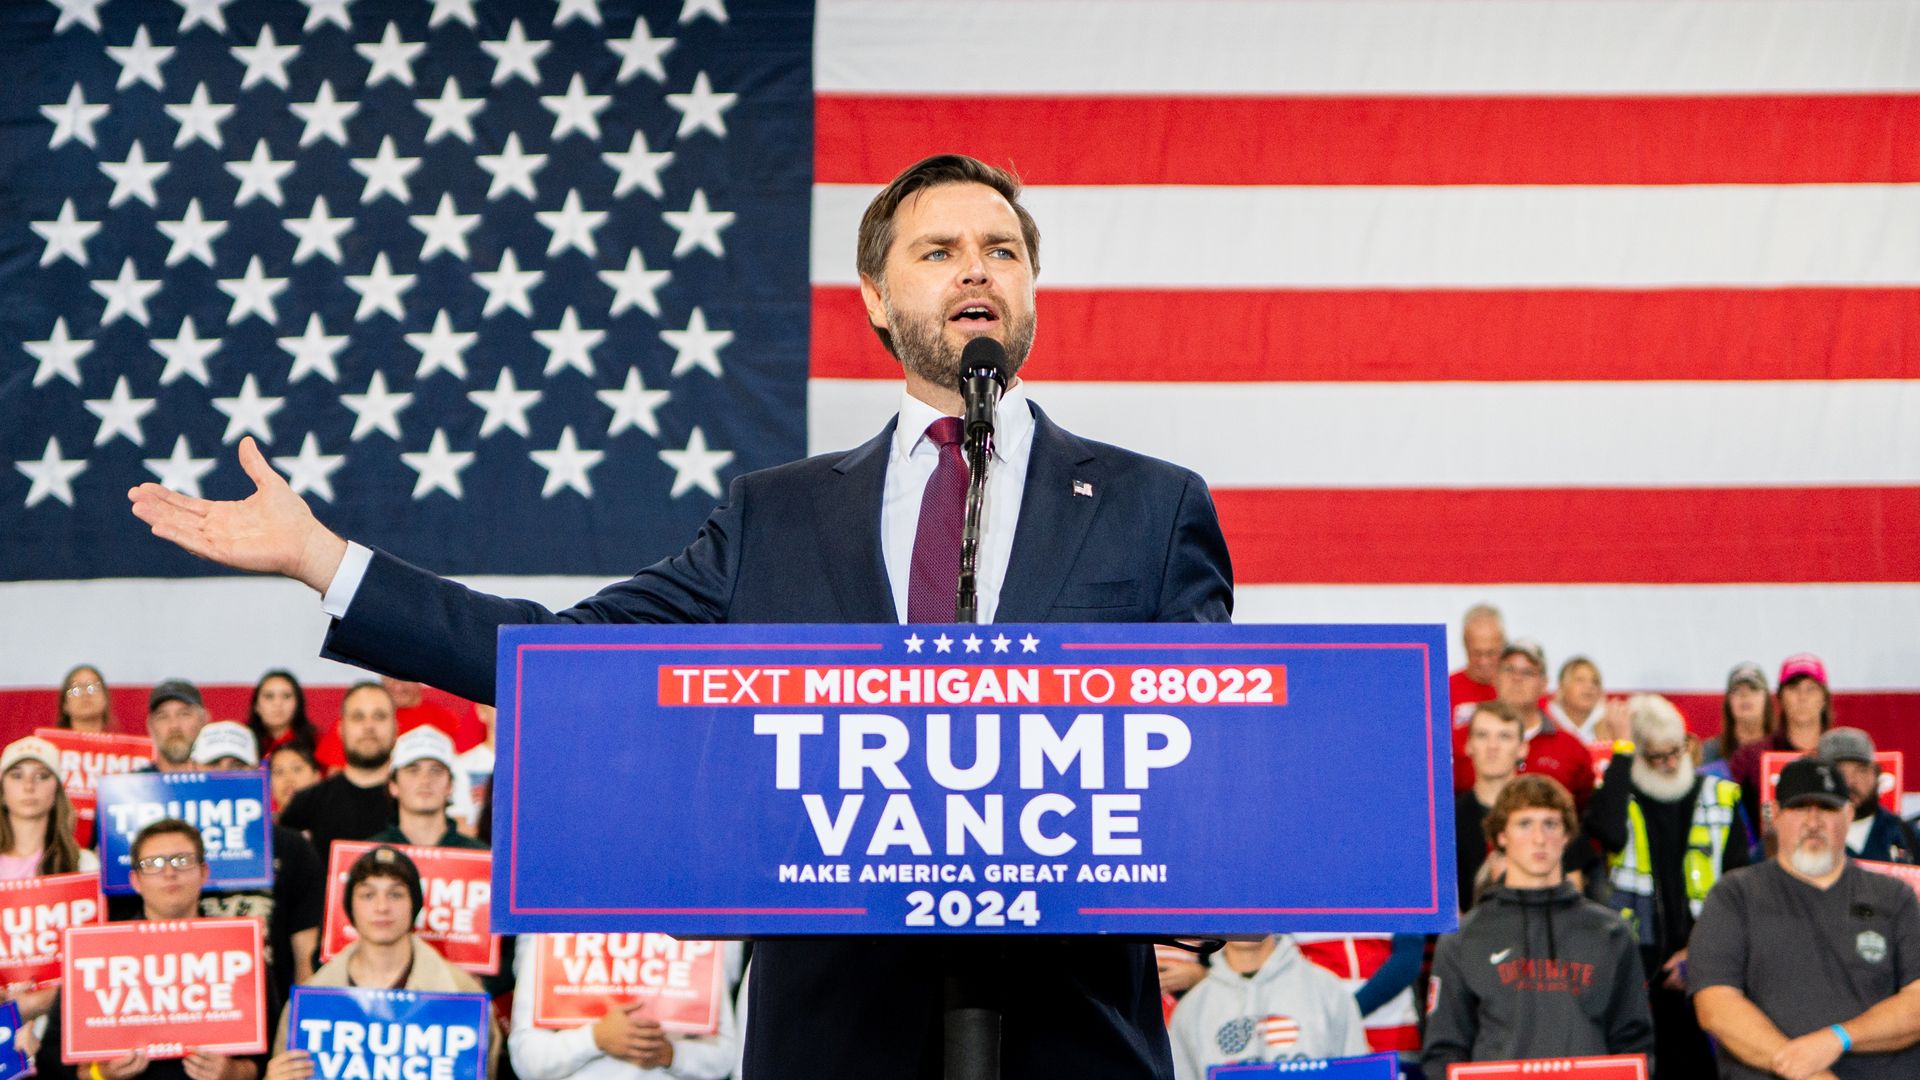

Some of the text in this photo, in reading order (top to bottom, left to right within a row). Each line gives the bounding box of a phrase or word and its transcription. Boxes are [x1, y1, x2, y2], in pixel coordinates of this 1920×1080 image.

[672, 668, 1273, 703] TEXT MICHIGAN TO 88022
[61, 750, 150, 774] RUMP
[753, 713, 1192, 790] TRUMP
[801, 793, 1142, 856] VANCE
[778, 864, 1167, 882] MAKE AMERICA GREAT AGAIN!
[2, 899, 97, 934] UMP
[905, 890, 1040, 926] 2024
[550, 933, 714, 962] TRUMP
[74, 951, 253, 991] TRUMP
[563, 957, 690, 987] VANCE
[96, 983, 235, 1015] VANCE
[300, 1019, 477, 1057] TRUMP
[317, 1051, 457, 1080] VANCE
